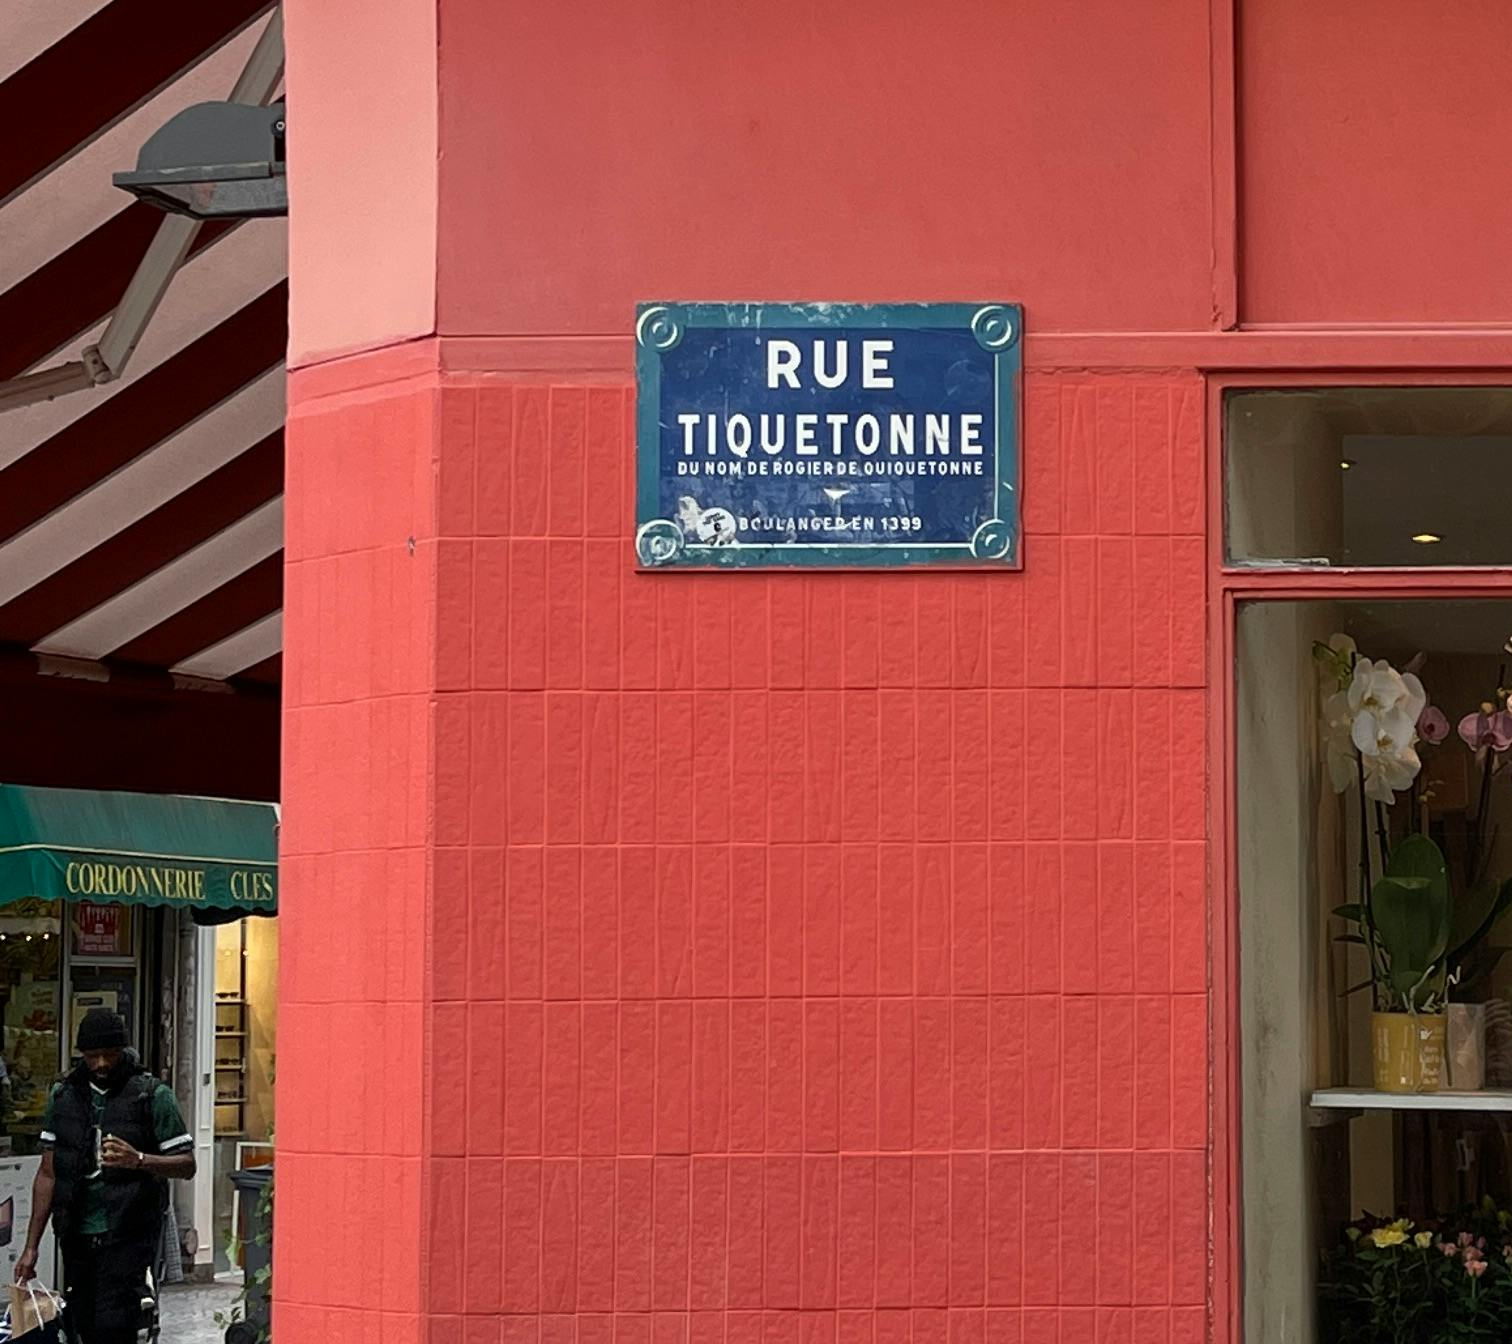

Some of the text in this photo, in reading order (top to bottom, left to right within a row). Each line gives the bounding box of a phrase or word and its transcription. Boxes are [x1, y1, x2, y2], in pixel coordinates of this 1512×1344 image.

[767, 340, 894, 389] RUE
[677, 414, 984, 458] TIQUETONNE
[677, 461, 699, 476] DU
[705, 461, 742, 476] NOM
[747, 461, 769, 476] DE
[773, 461, 833, 476] ROGIER
[837, 461, 857, 476] DE
[851, 516, 875, 531] EN
[880, 516, 923, 531] 1399
[66, 861, 274, 901] CORDONNERIE CLES
